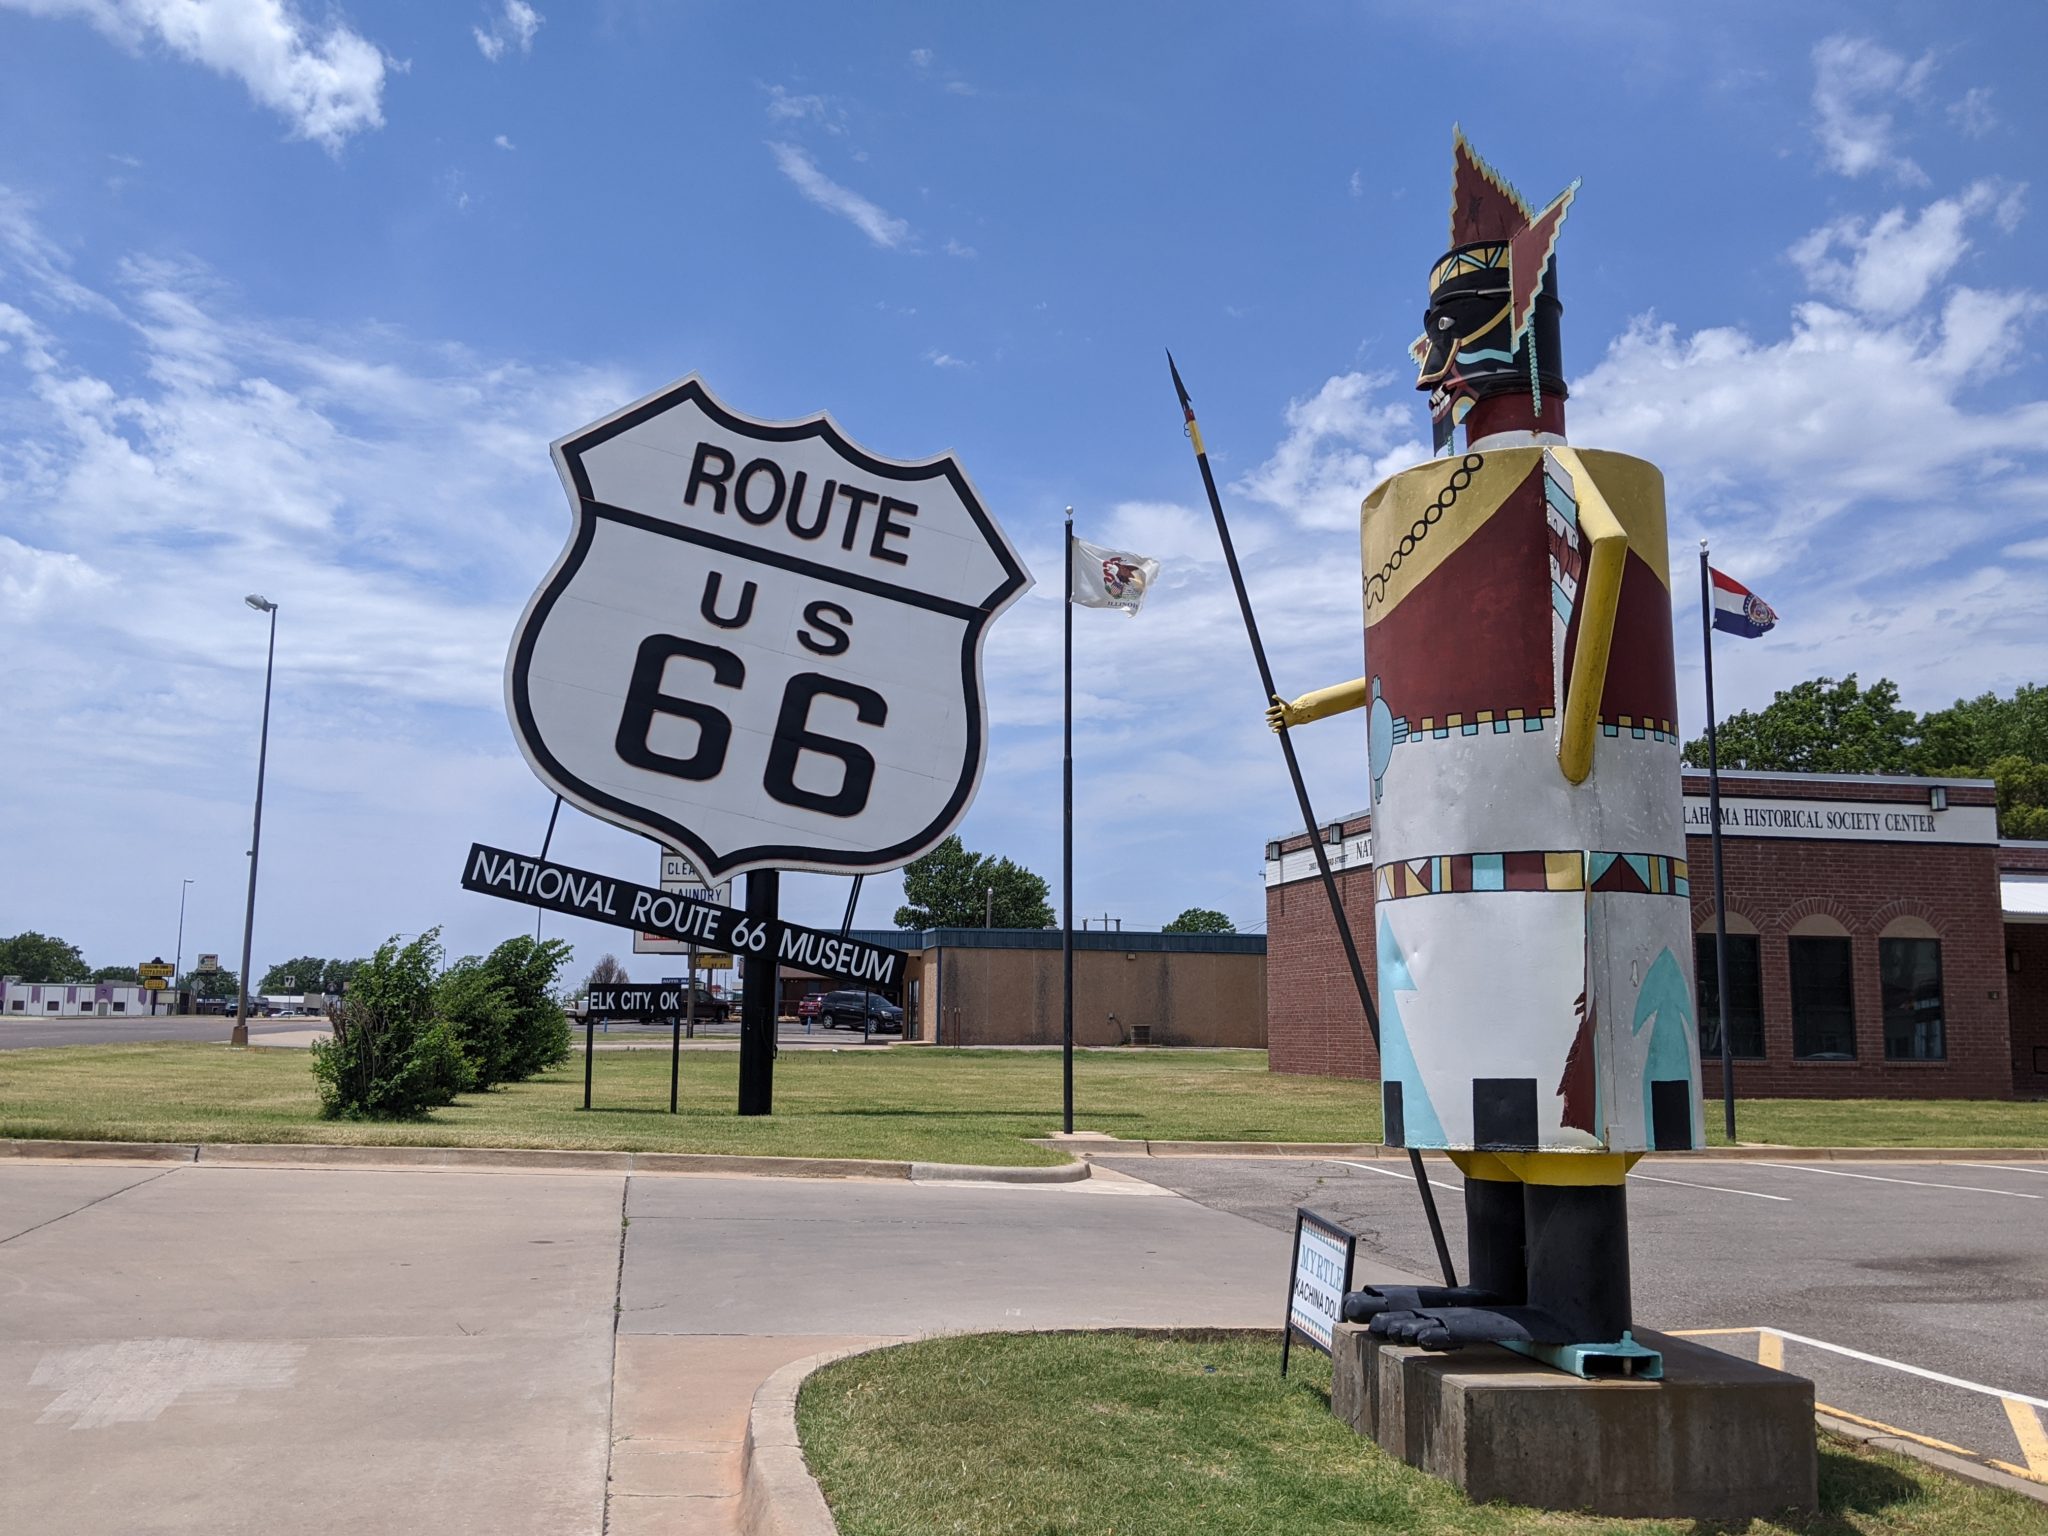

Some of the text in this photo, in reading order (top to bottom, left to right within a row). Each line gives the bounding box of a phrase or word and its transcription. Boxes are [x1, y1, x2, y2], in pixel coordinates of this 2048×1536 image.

[683, 441, 919, 566] ROUTE
[614, 633, 889, 818] 66
[1744, 808, 1822, 828] HISTORICAL
[1827, 811, 1881, 831] SOCIETY
[1885, 813, 1936, 832] CENTER
[471, 850, 896, 984] NATIONAL ROUTE 66 MUSEUM
[589, 990, 679, 1013] ELK CITY, OK
[1300, 1245, 1343, 1292] MYRTLE
[1294, 1276, 1324, 1313] KACHINA
